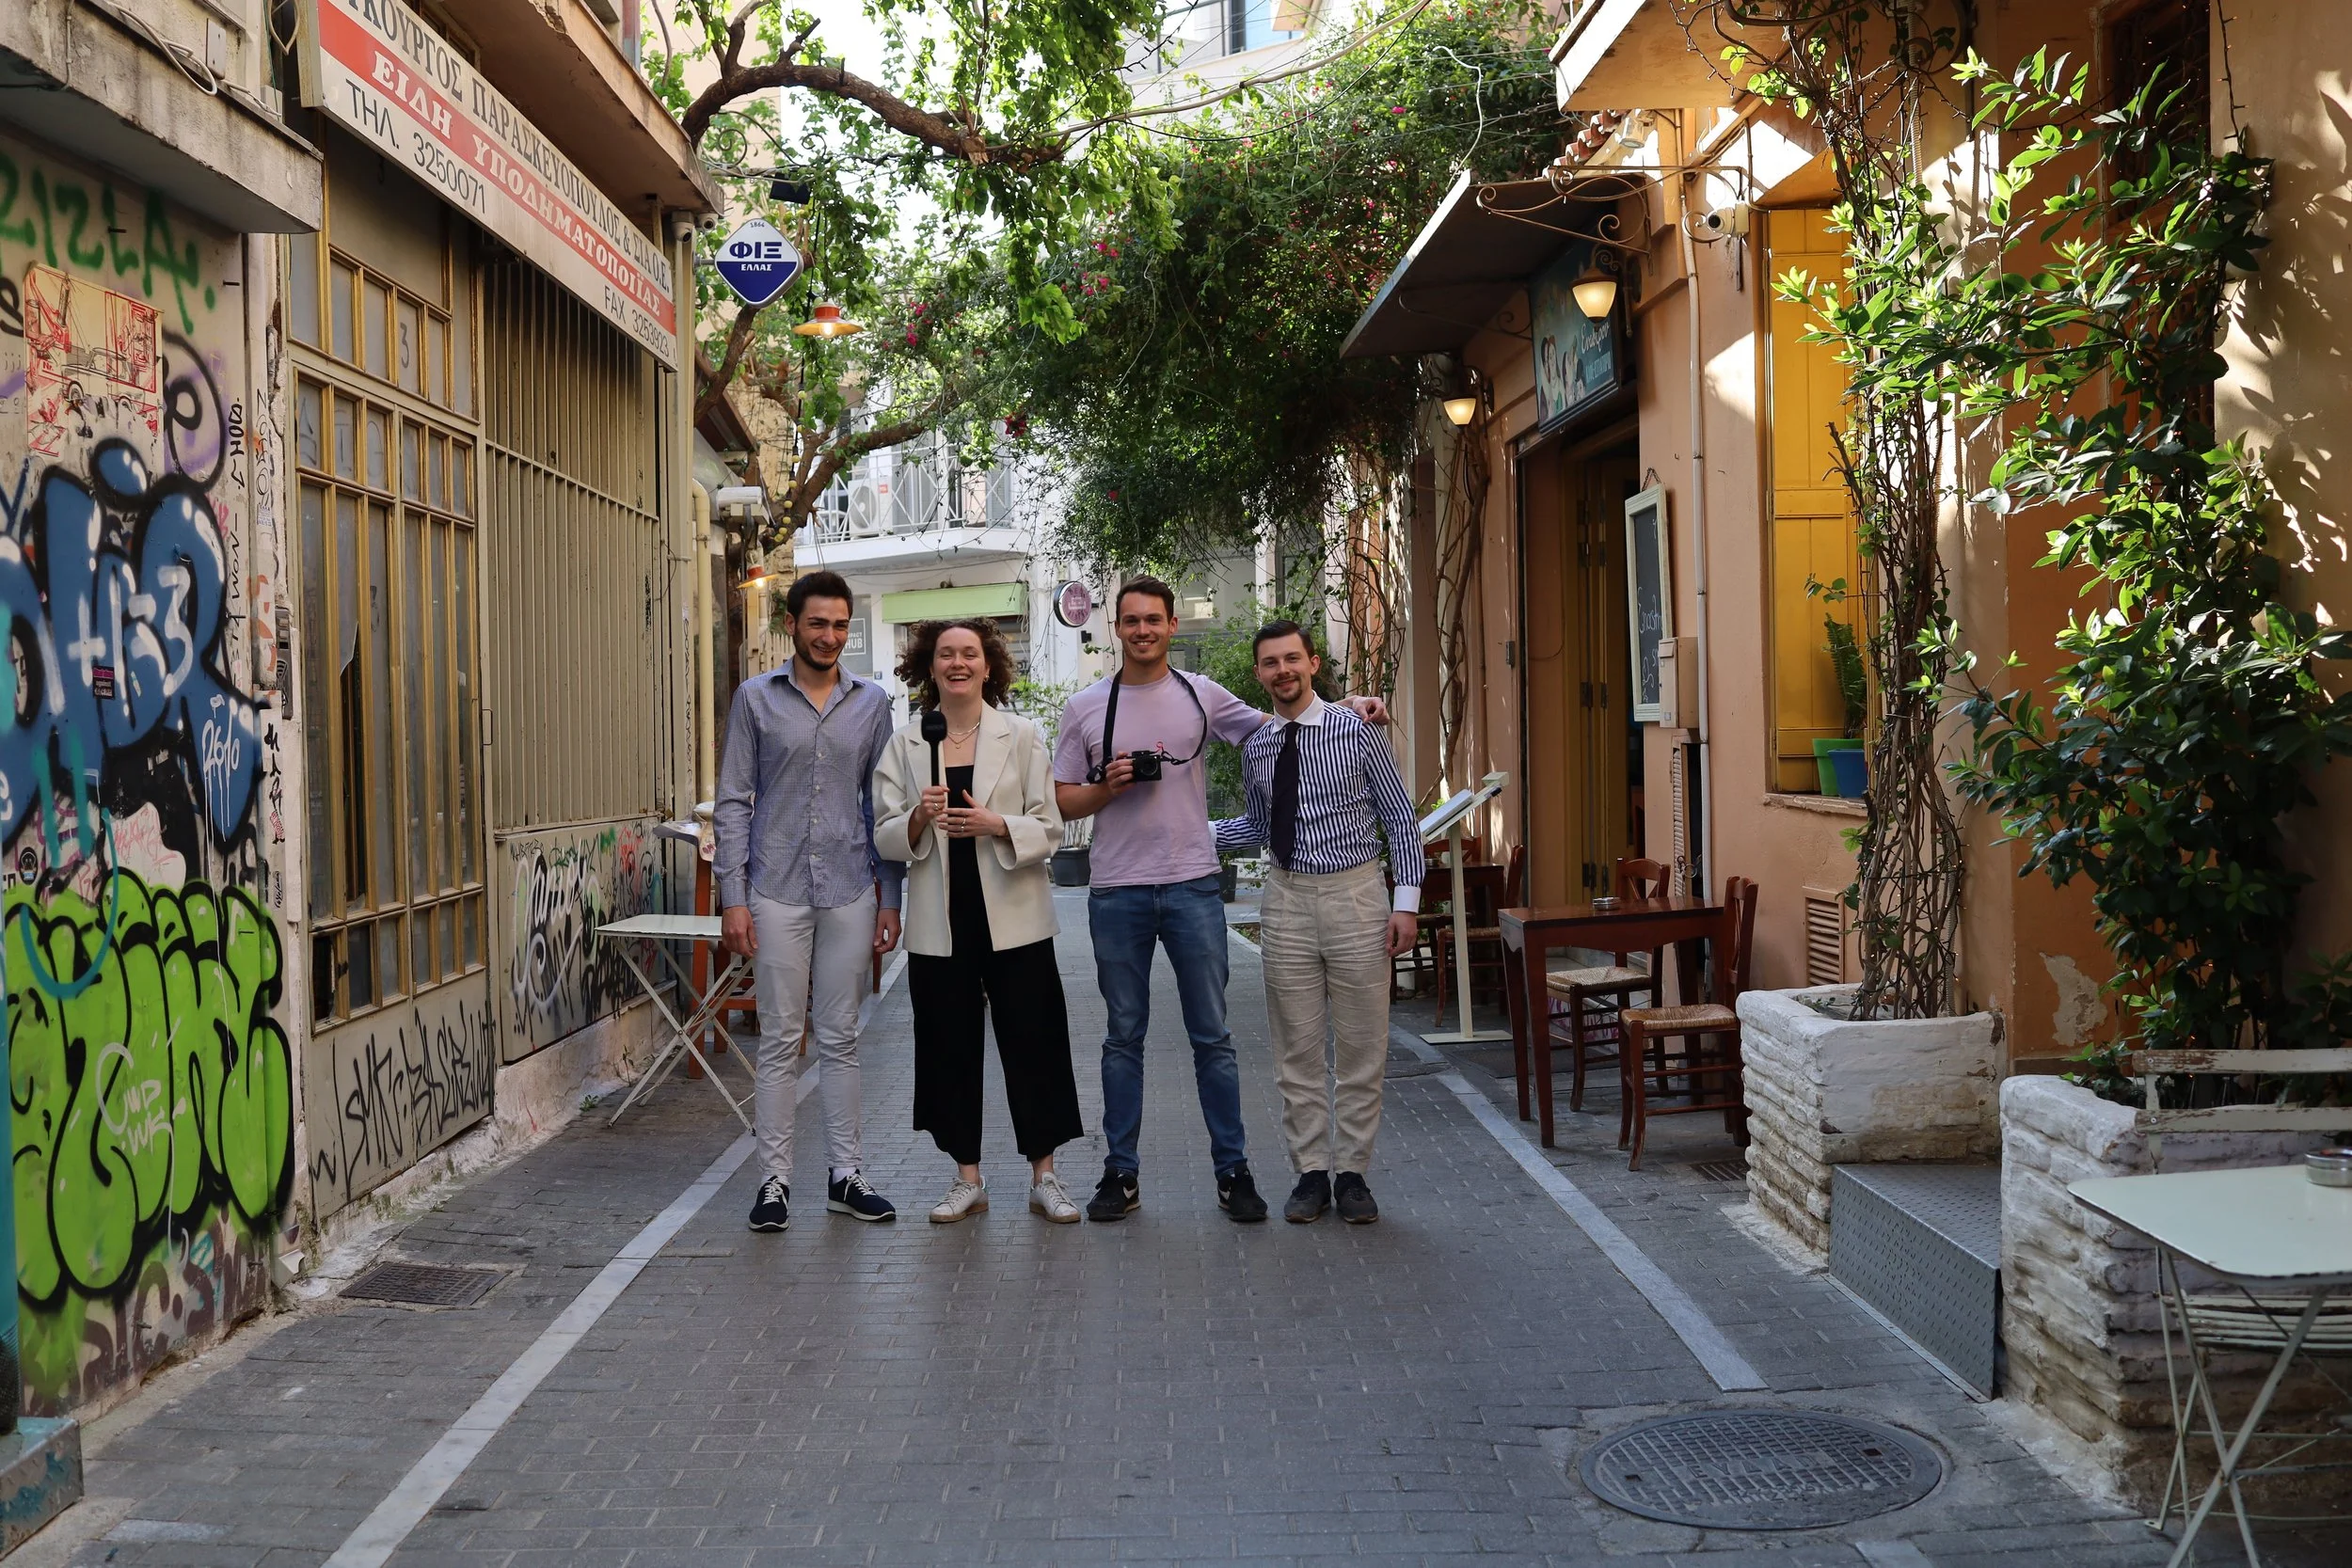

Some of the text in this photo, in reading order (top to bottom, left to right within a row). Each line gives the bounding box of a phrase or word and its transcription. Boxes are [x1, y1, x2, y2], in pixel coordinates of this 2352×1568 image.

[372, 50, 453, 139] ΕΙΔΗ
[345, 78, 486, 214] ΤΗΛ. 3250071
[472, 81, 621, 246] ΠΑΡΑΣΚΕΥΟΠΟΥΛΟΣ
[623, 225, 631, 256] &
[633, 231, 651, 275] ΣΙΑ
[729, 241, 782, 259] ΦΙΞ
[740, 263, 772, 272] ΕΛΛΑΣ
[604, 285, 627, 325] FAX
[631, 309, 670, 358] 3253923
[845, 638, 864, 649] HUB
